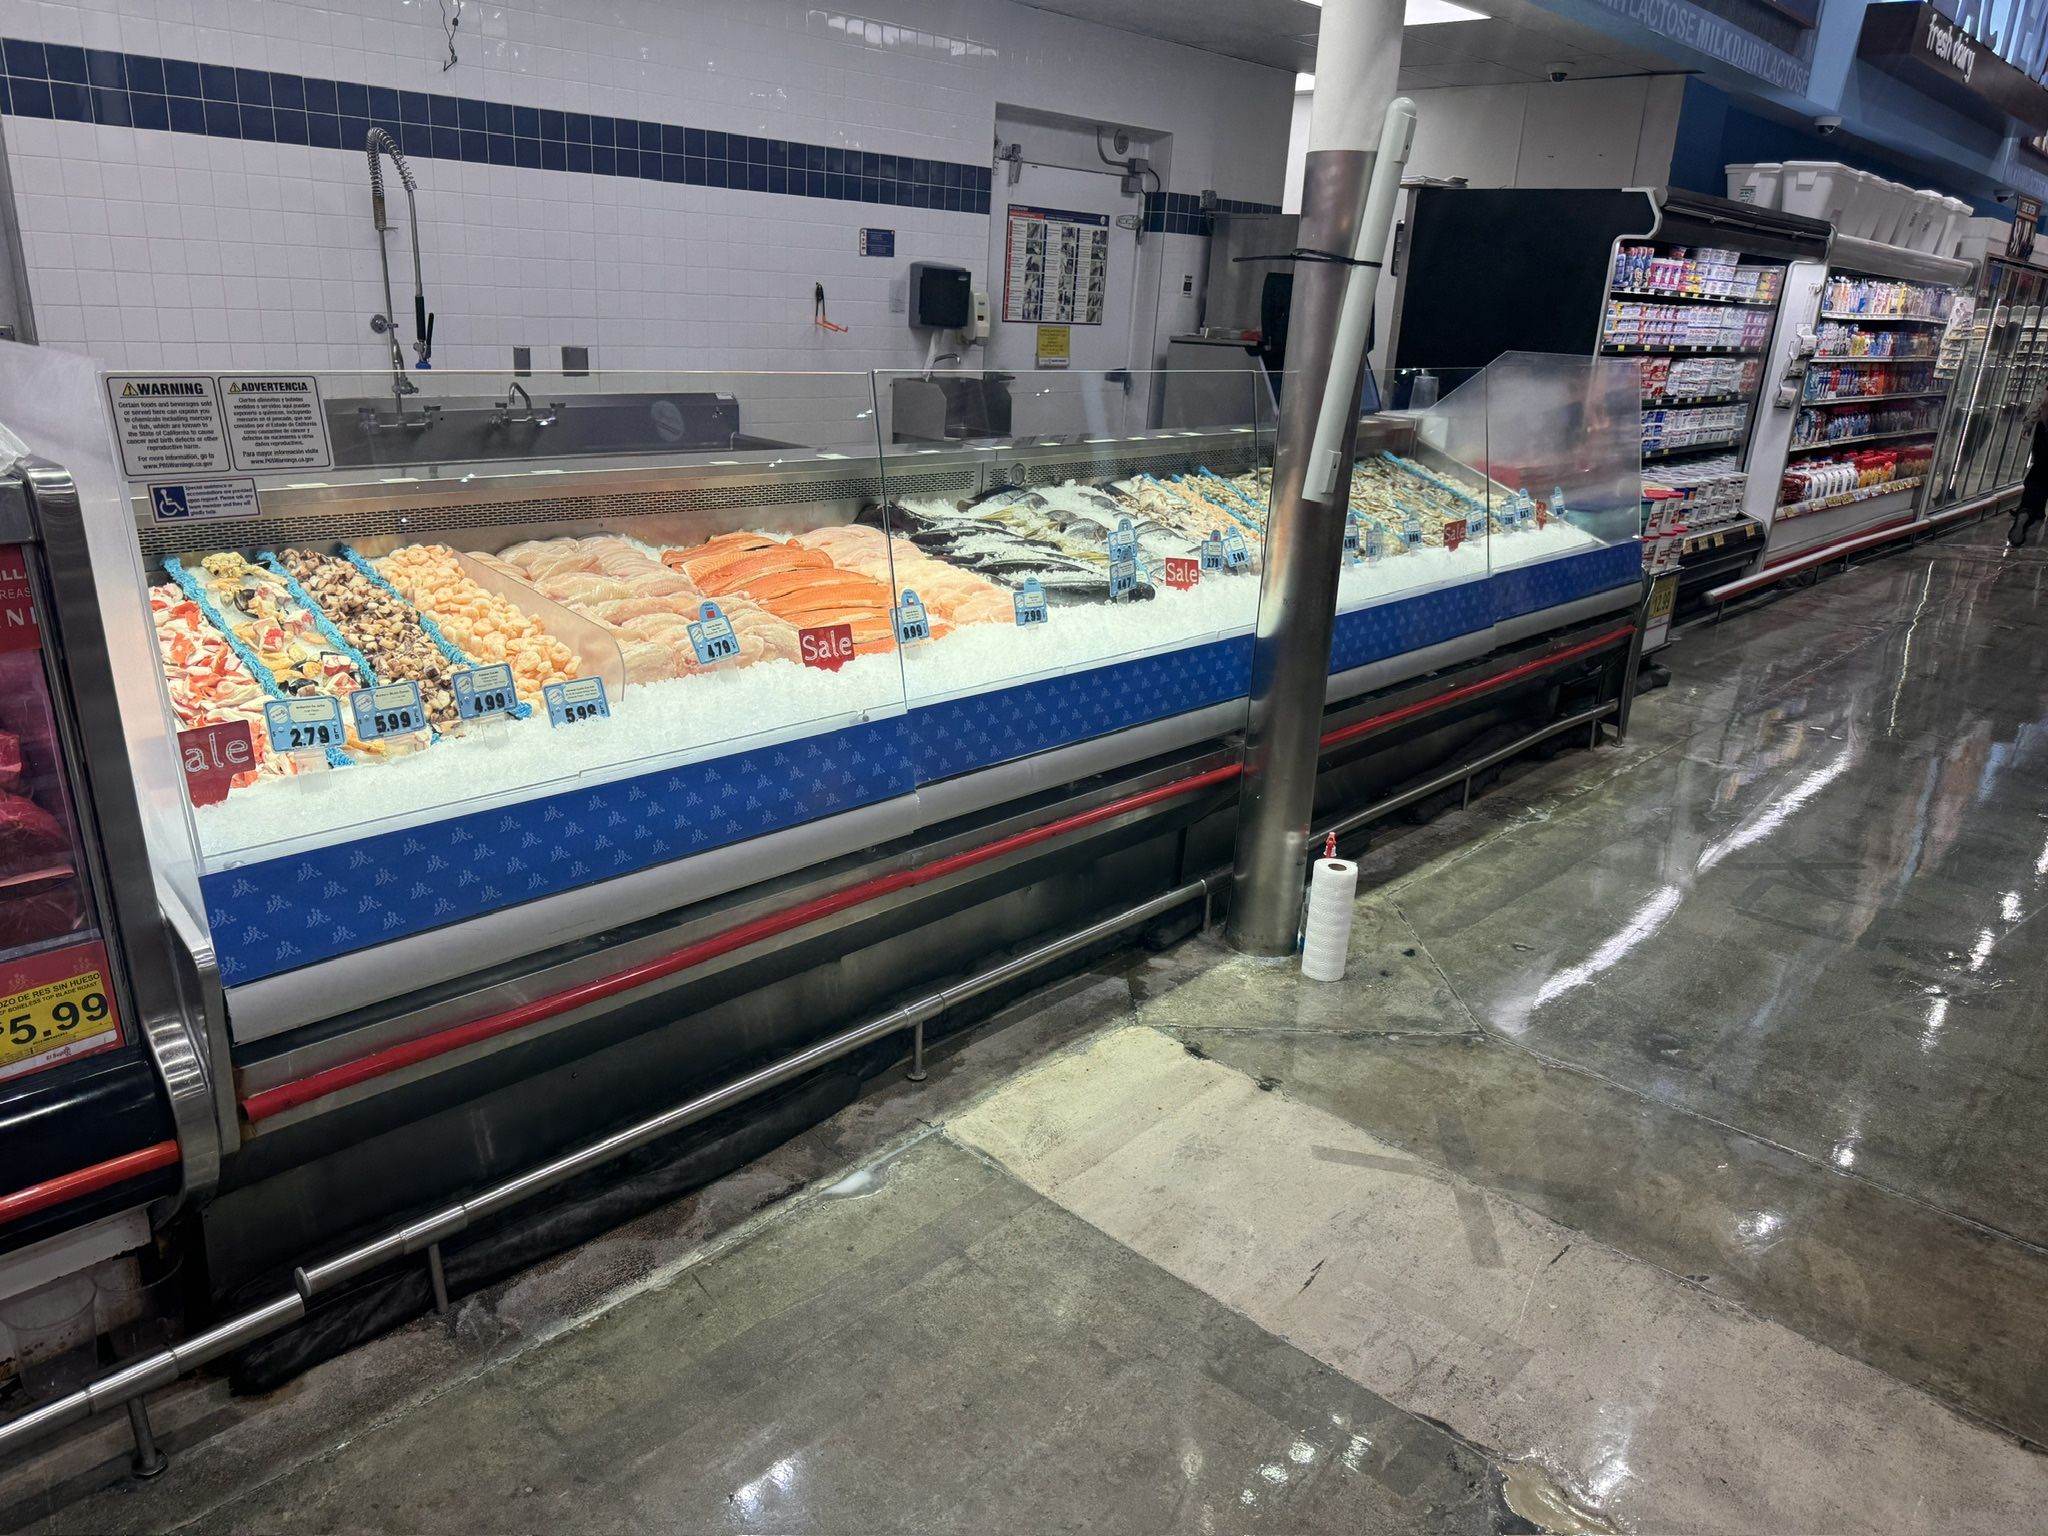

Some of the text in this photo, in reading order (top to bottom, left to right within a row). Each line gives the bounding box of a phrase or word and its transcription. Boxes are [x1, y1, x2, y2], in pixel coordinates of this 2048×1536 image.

[1926, 13, 1976, 83] fresh dairy
[137, 383, 204, 395] WARNING
[242, 382, 308, 391] ADVERTENCIA
[1444, 526, 1466, 543] Sale
[0, 569, 28, 581] LL
[1166, 561, 1198, 583] Sale
[802, 629, 852, 661] Sale
[474, 692, 505, 713] 4.99
[374, 711, 411, 733] 5.99
[289, 725, 330, 747] 2.79
[185, 732, 250, 773] ale
[18, 993, 30, 1002] DE
[32, 987, 51, 998] RES
[53, 982, 68, 992] SIN
[70, 972, 100, 988] HUESO
